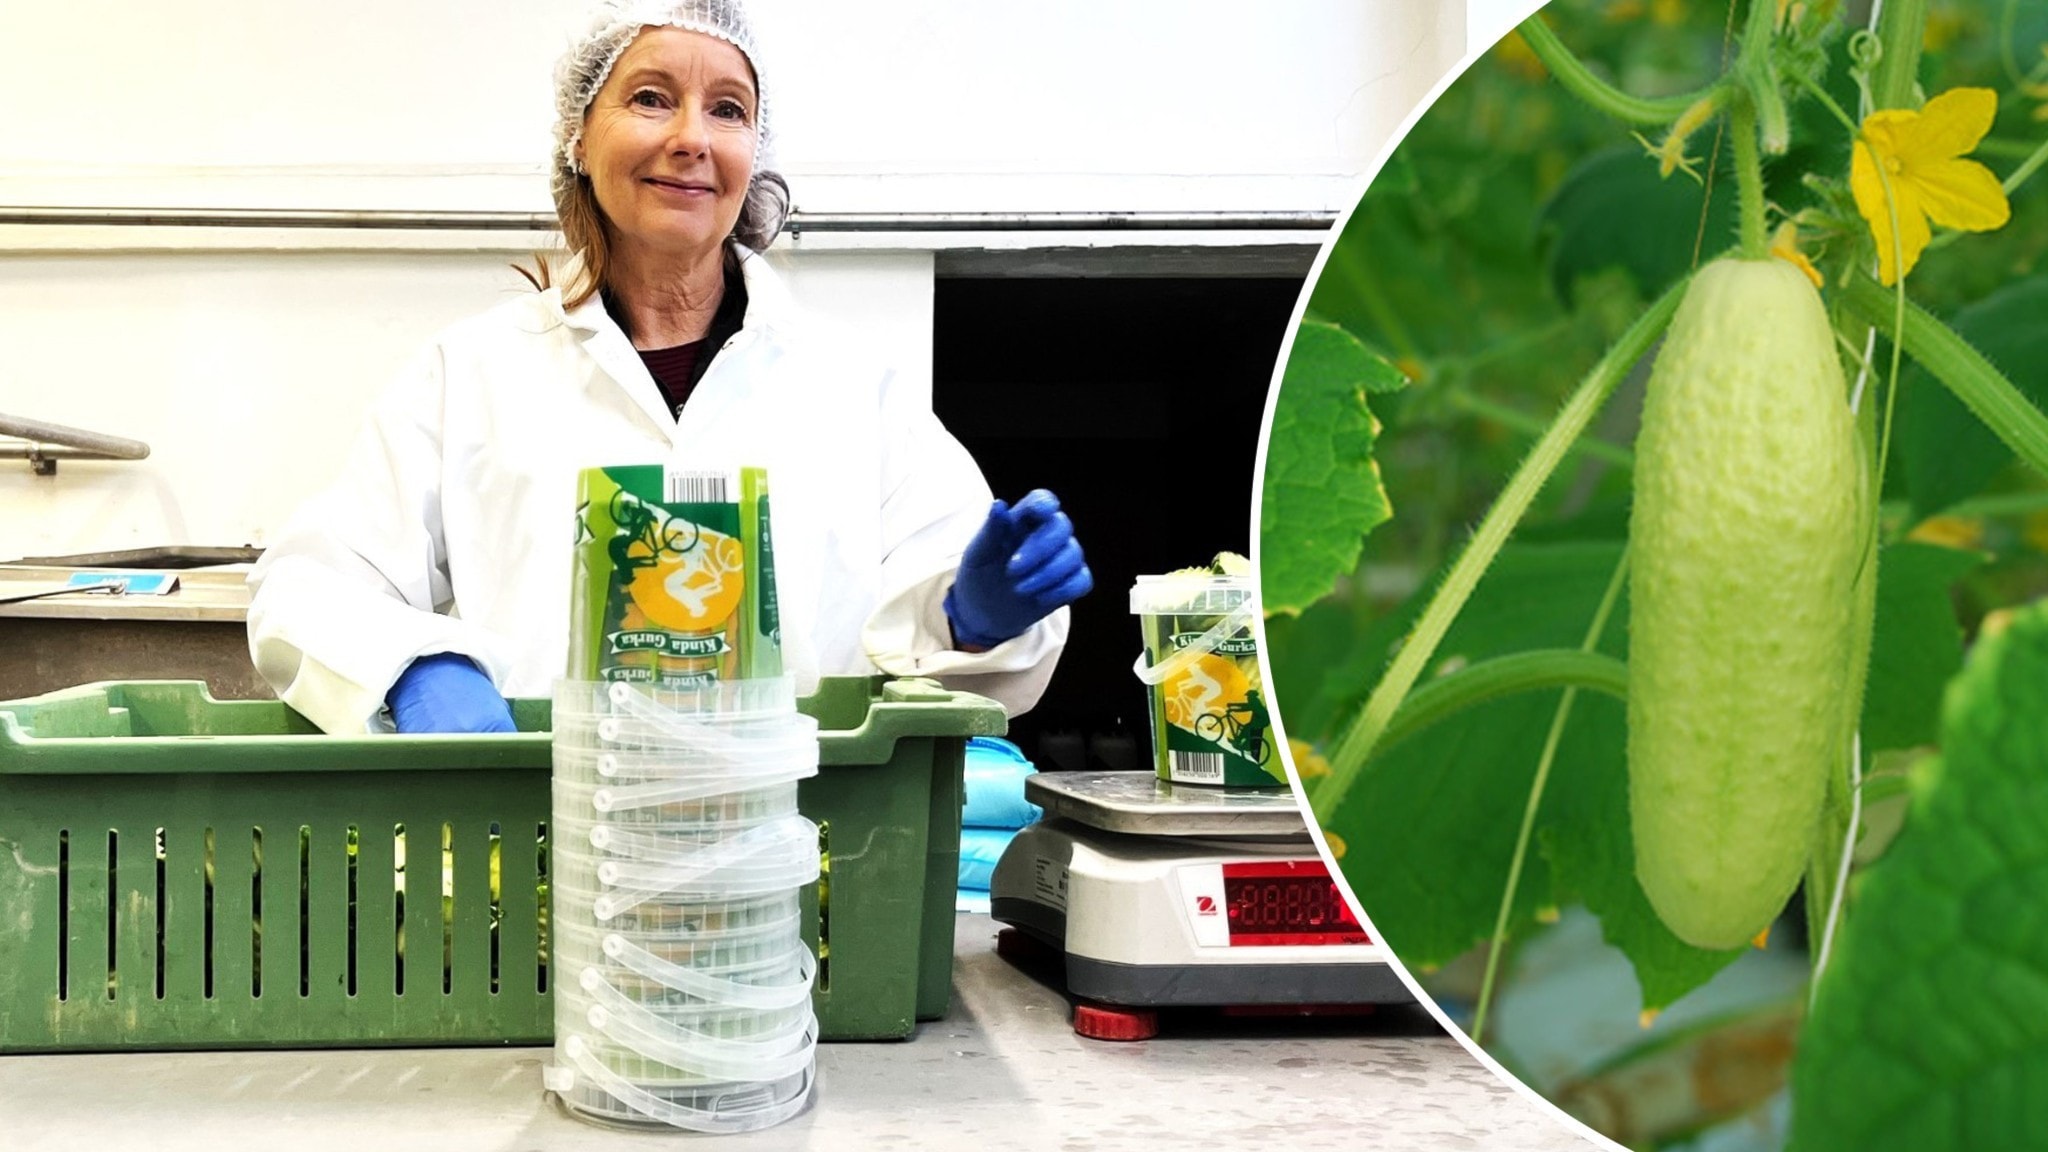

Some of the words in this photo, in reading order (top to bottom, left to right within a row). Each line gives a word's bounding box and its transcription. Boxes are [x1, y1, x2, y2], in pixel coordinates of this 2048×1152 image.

[620, 633, 667, 648] Gurka
[671, 638, 717, 654] Kinda
[1218, 641, 1256, 652] Gurka
